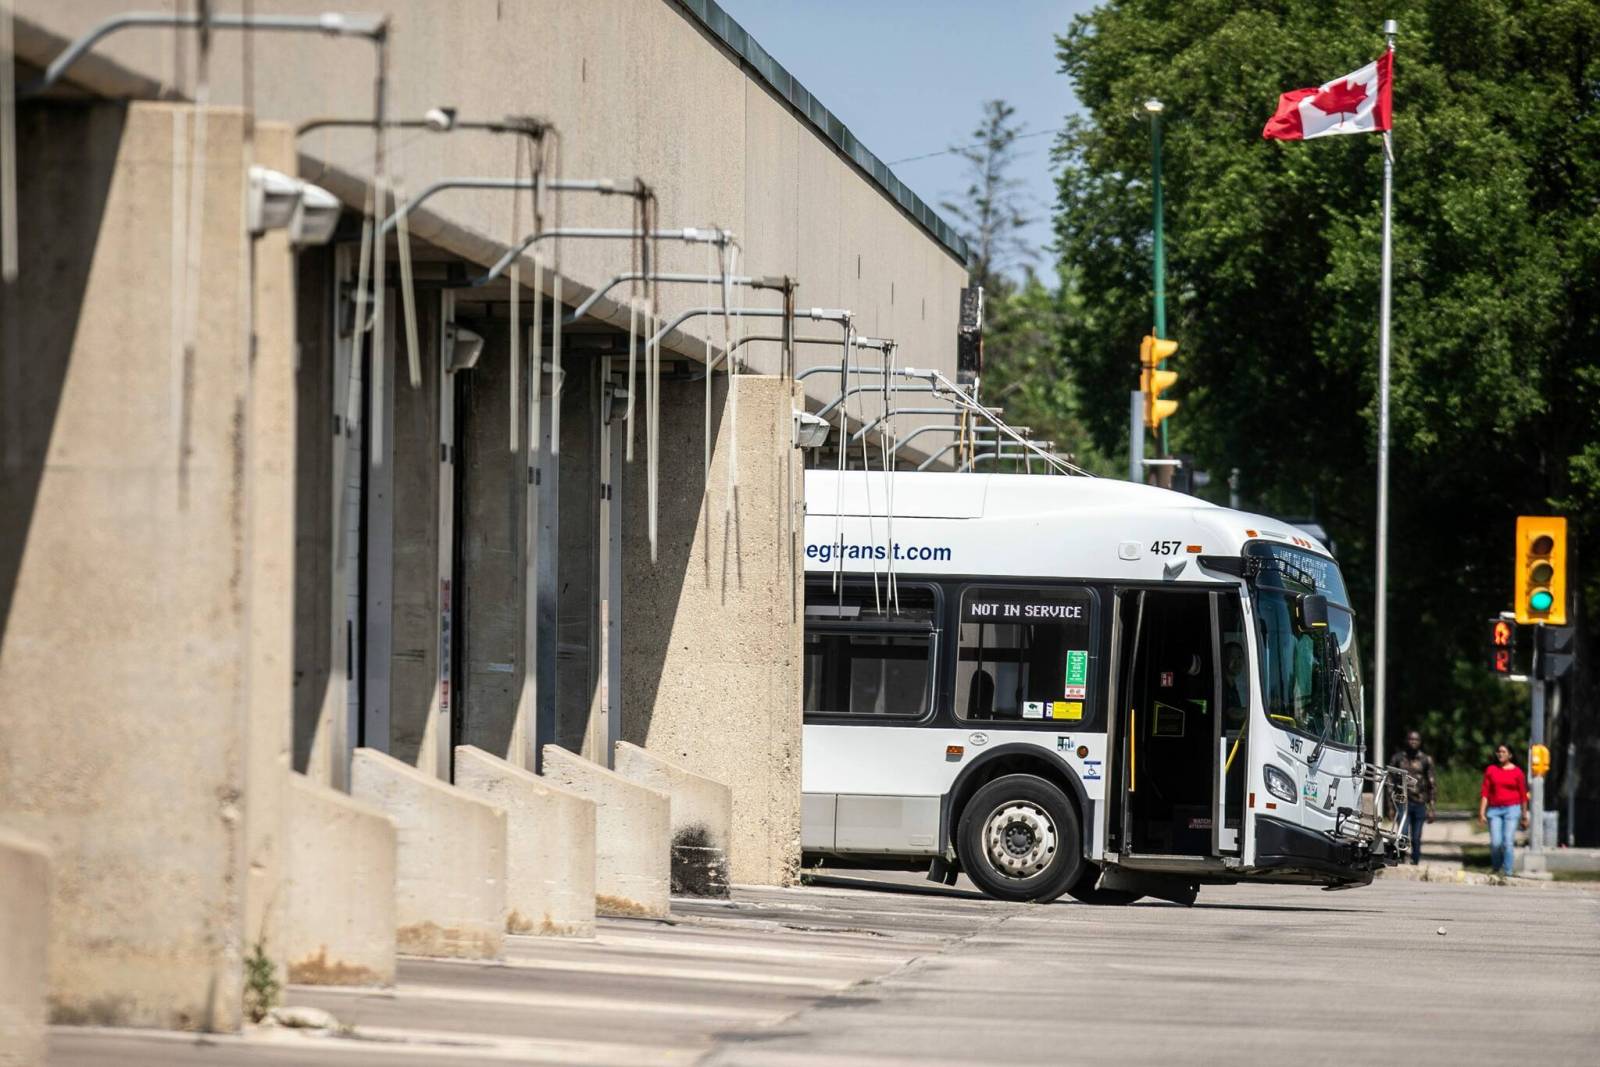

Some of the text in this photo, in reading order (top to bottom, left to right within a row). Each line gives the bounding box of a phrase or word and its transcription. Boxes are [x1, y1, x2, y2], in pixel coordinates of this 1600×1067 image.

[803, 542, 951, 563] egtranst.com
[1150, 540, 1182, 555] 457
[971, 603, 1082, 618] NOT IN SERVICE
[1290, 738, 1304, 754] 457
